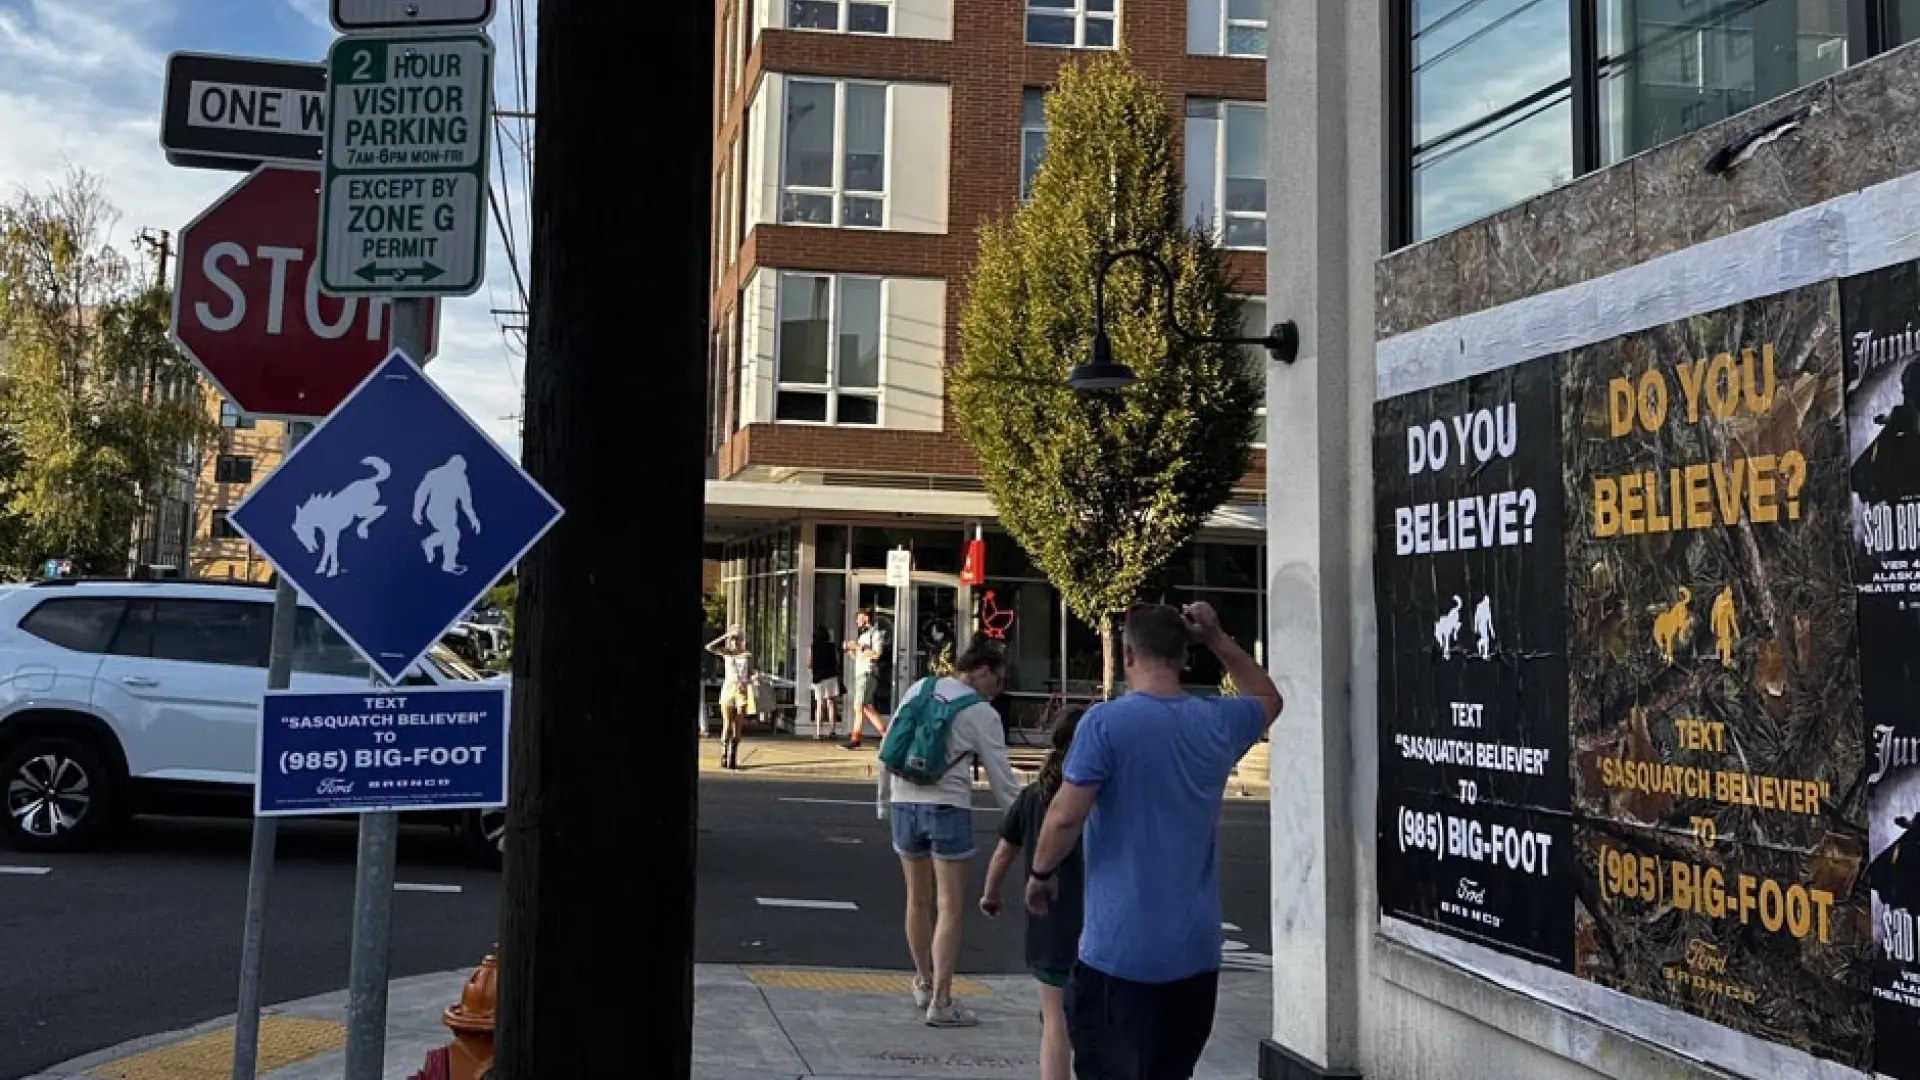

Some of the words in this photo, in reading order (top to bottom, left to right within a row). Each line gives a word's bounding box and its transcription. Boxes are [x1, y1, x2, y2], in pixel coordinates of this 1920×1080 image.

[351, 50, 373, 80] 2
[394, 53, 461, 79] HOUR
[200, 87, 282, 128] ONE
[353, 86, 463, 114] VISITOR
[346, 116, 467, 147] PARKING
[411, 150, 464, 164] MON-FRI
[349, 179, 426, 200] EXCEPT
[431, 178, 459, 199] BY
[348, 204, 424, 233] ZONE
[434, 204, 455, 232] G
[362, 238, 438, 259] PERMIT
[1609, 368, 1668, 438] DO
[1676, 343, 1776, 423] YOU
[1407, 419, 1448, 474] DO
[1453, 402, 1517, 466] YOU
[1593, 450, 1807, 539] BELIEVE?
[1395, 487, 1537, 556] BELIEVE?
[363, 697, 408, 710] TEXT
[1450, 702, 1484, 728] TEXT
[281, 714, 393, 730] "SASQUATCH
[397, 711, 487, 726] BELIEVER"
[1674, 719, 1725, 752] TEXT
[373, 731, 397, 744] TO
[279, 748, 348, 775] (985)
[354, 745, 487, 768] BIG-FOOT
[1395, 733, 1474, 766] "SASQUATCH
[1476, 742, 1549, 776] BELIEVER"
[315, 777, 355, 795] Ford
[368, 778, 450, 789] BRONCO
[1458, 779, 1478, 805] TO
[1715, 771, 1831, 815] BELIEVER"
[1399, 805, 1444, 862] (985)
[1447, 815, 1552, 876] BIG-FOOT
[1690, 815, 1717, 849] TO
[1456, 877, 1486, 905] Ford
[1600, 844, 1664, 908] (985)
[1671, 860, 1835, 944] BIG-FOOT
